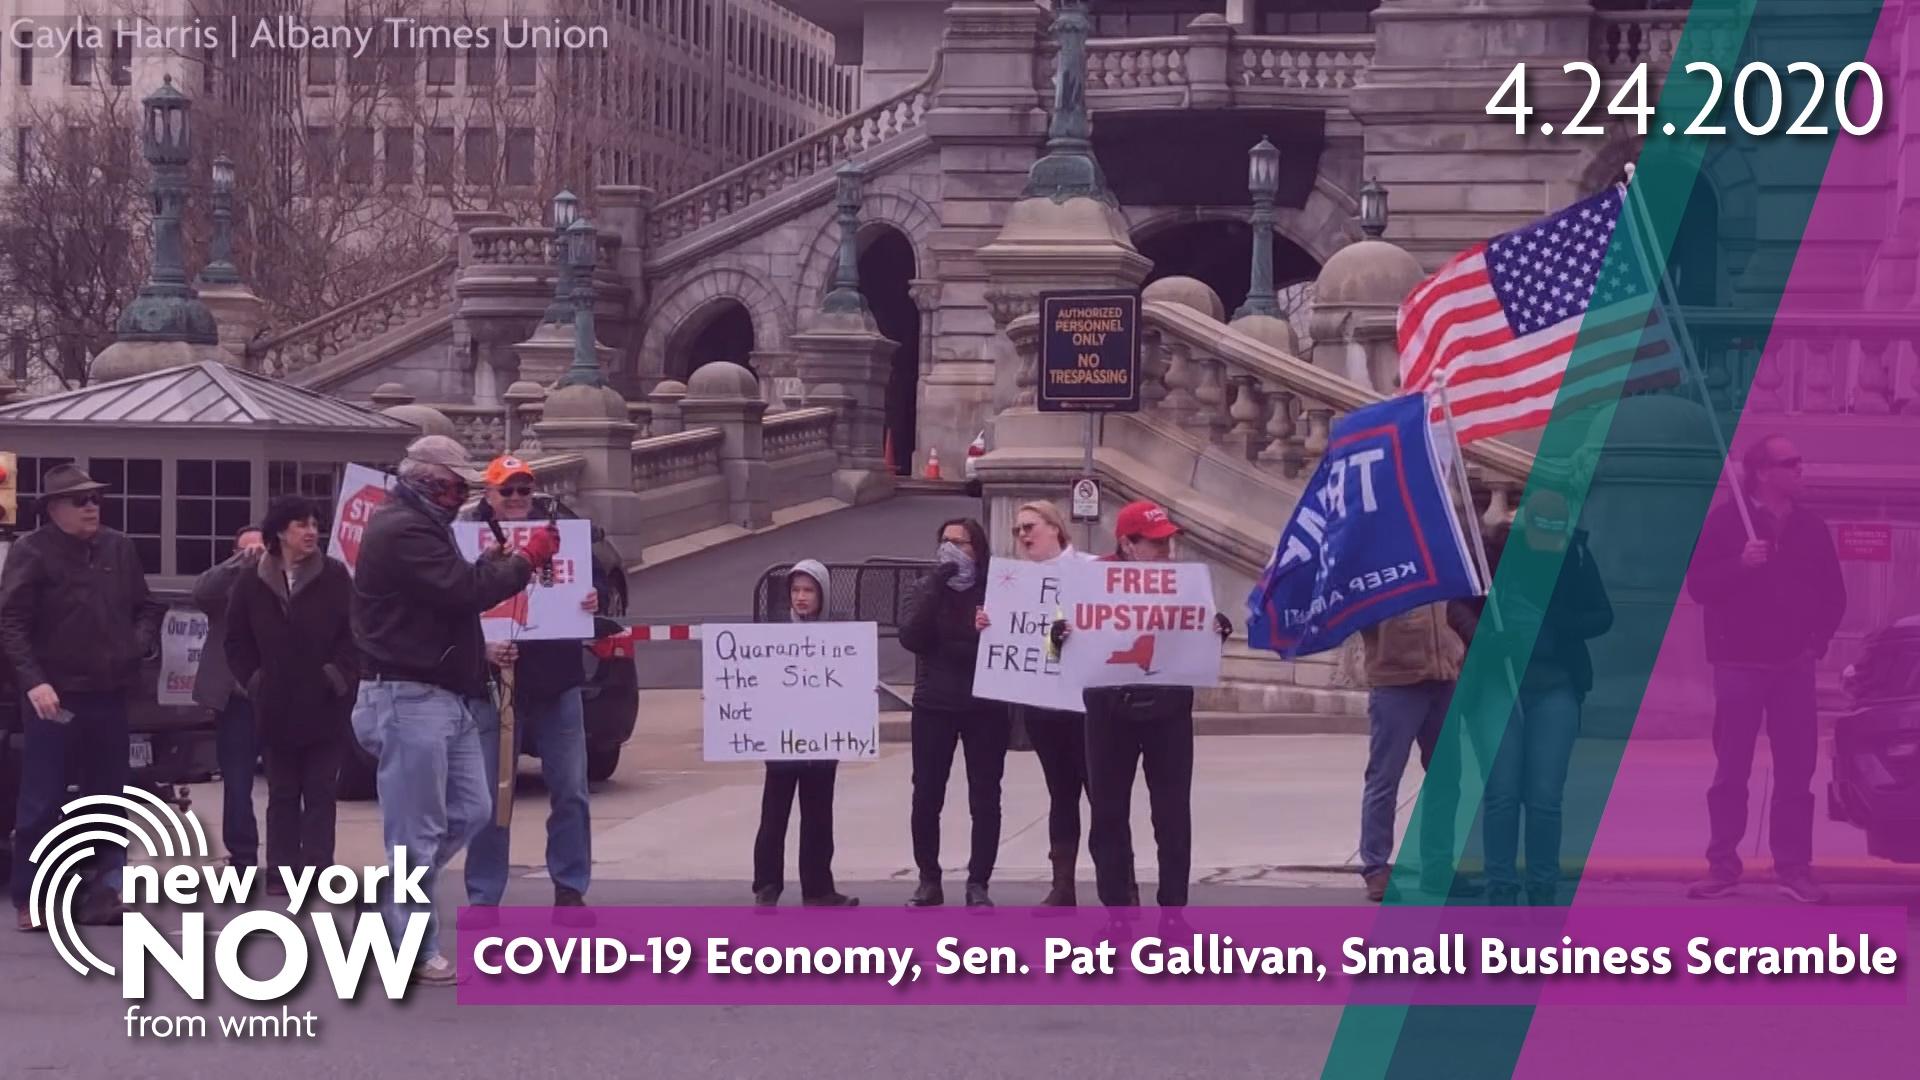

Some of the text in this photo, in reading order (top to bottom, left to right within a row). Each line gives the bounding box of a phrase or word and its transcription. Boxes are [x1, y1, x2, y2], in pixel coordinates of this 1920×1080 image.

[1058, 307, 1123, 318] AUTHORIZED
[1055, 319, 1124, 332] PERSONNEL
[1072, 333, 1106, 346] ONLY
[1078, 353, 1100, 368] NO
[1049, 369, 1128, 384] TRESPASSING
[1106, 567, 1177, 595] FREE
[168, 617, 188, 635] Our
[1009, 611, 1050, 636] Not
[1075, 603, 1206, 632] UPSTATE!
[715, 630, 858, 662] Quarantine
[715, 667, 759, 689] the
[719, 702, 752, 721] Not
[728, 727, 876, 756] the Healthy!
